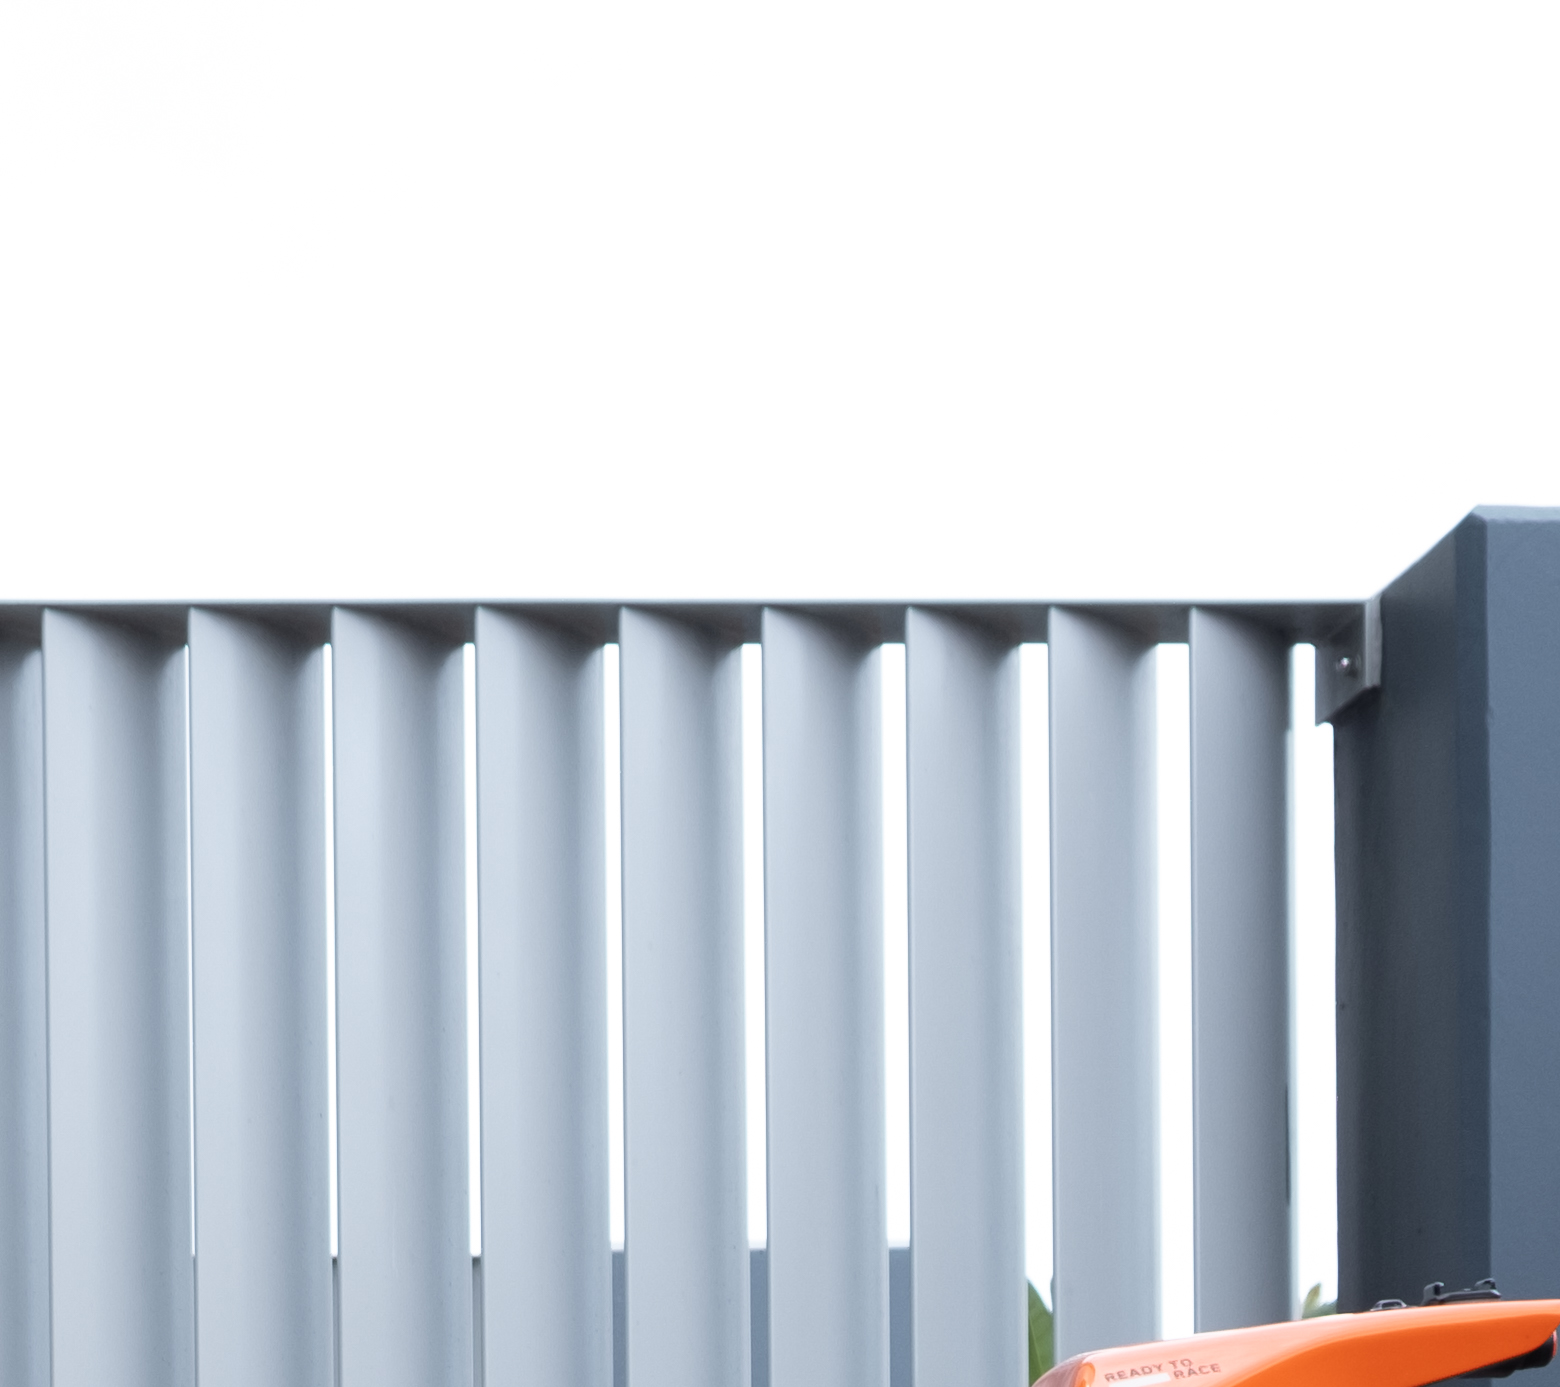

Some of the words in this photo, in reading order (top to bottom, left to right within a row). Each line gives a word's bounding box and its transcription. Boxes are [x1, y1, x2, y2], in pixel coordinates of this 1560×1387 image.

[1104, 1363, 1163, 1382] READY
[1169, 1358, 1193, 1370] TO
[1173, 1363, 1221, 1379] RACE
